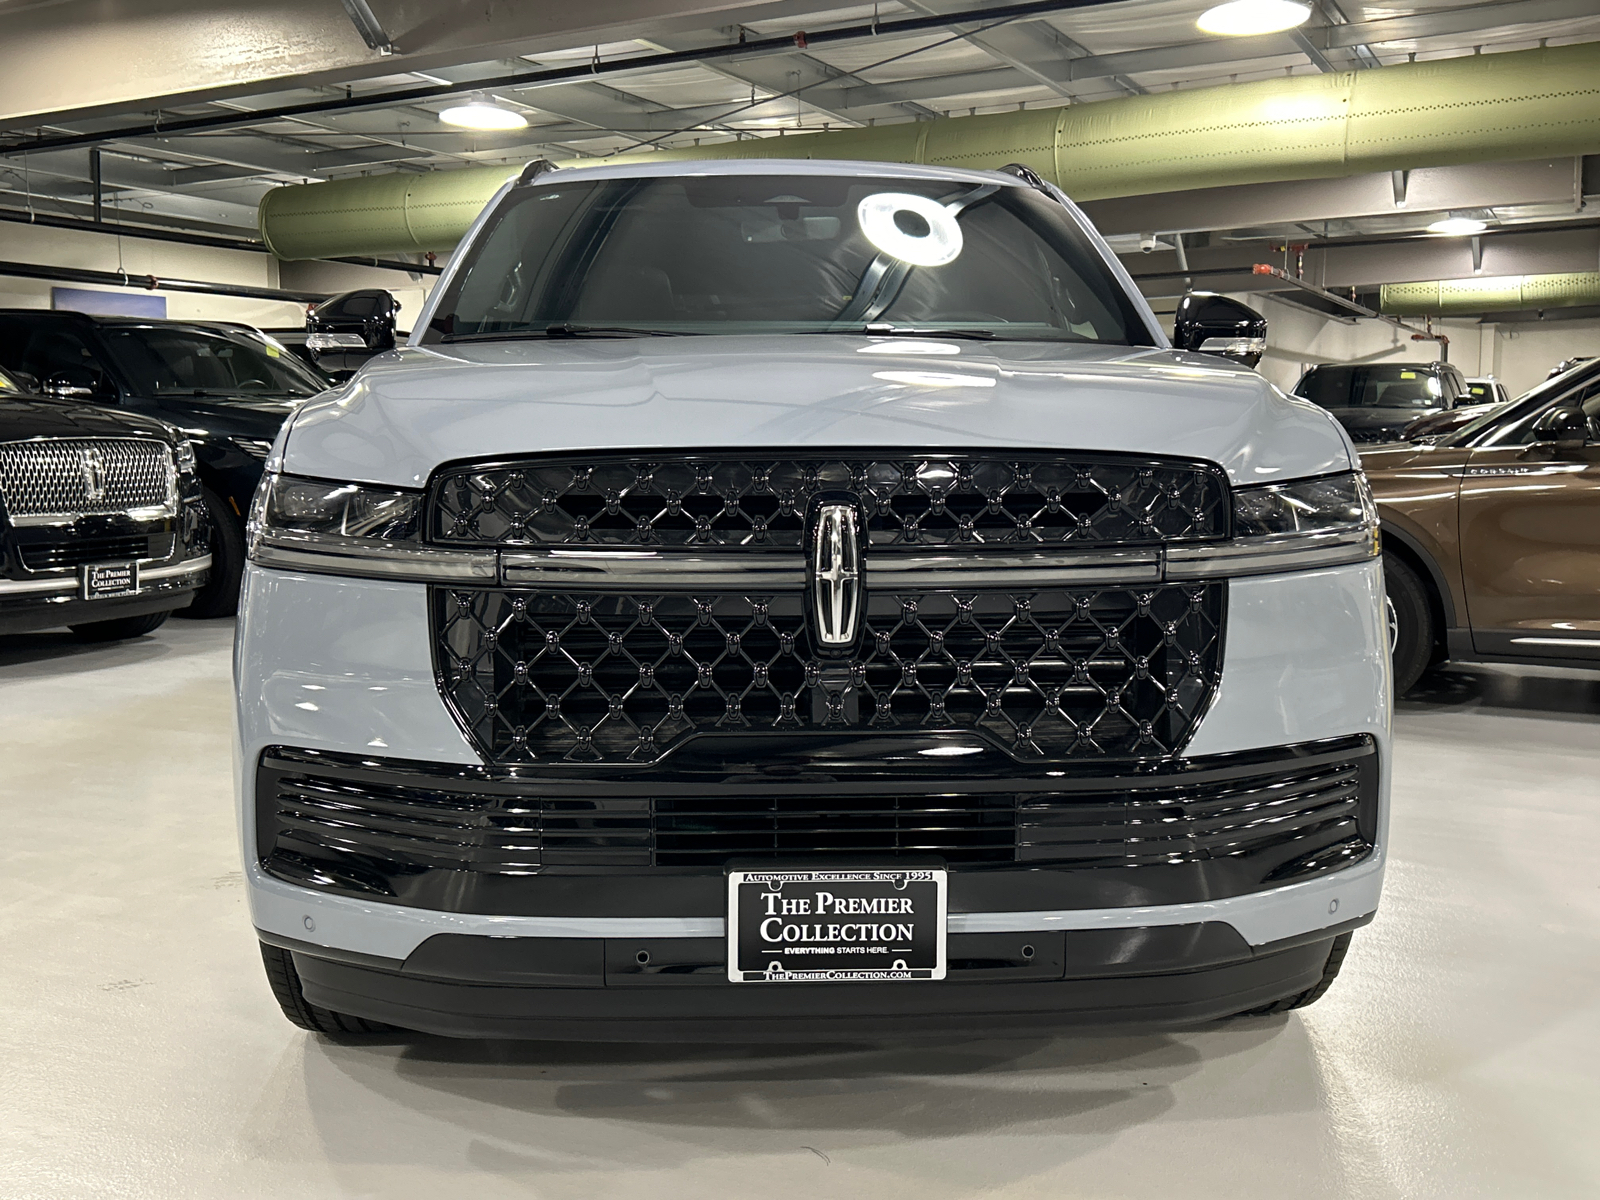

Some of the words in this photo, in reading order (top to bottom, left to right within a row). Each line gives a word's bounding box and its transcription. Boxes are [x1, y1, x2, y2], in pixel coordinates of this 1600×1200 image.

[92, 571, 104, 580] THE
[105, 570, 131, 579] PREMIER
[91, 578, 131, 588] COLLECTION
[745, 873, 808, 881] AUTOMOTIVE
[811, 872, 871, 880] EXCELLENCE
[873, 872, 902, 880] SINCE
[905, 872, 932, 880] 1995
[760, 892, 811, 915] THE
[815, 891, 914, 914] PREMIER
[760, 917, 914, 942] COLLECTION
[784, 946, 835, 954] EVERYTHING
[836, 946, 865, 954] STARTS
[866, 946, 889, 954] HERE.
